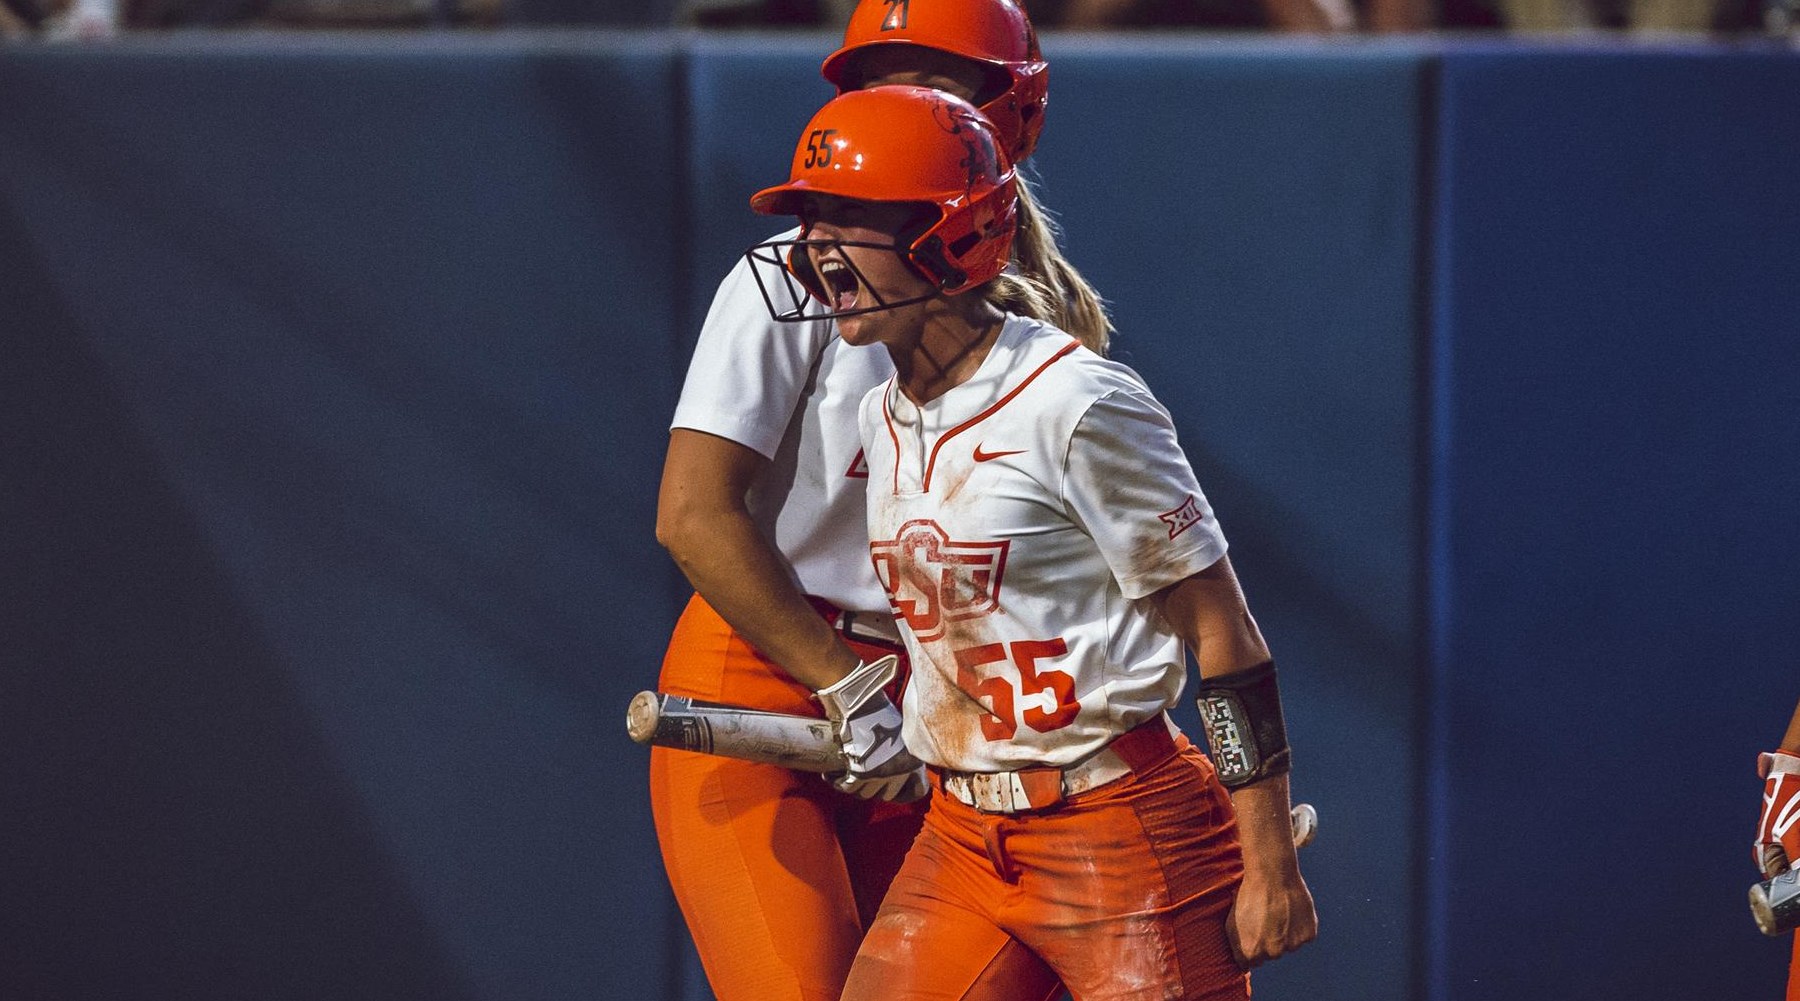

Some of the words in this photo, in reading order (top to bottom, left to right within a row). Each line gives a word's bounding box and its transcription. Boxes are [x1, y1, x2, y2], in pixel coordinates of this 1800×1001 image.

[880, 0, 910, 31] 21
[804, 129, 838, 169] 55
[953, 637, 1082, 742] 55
